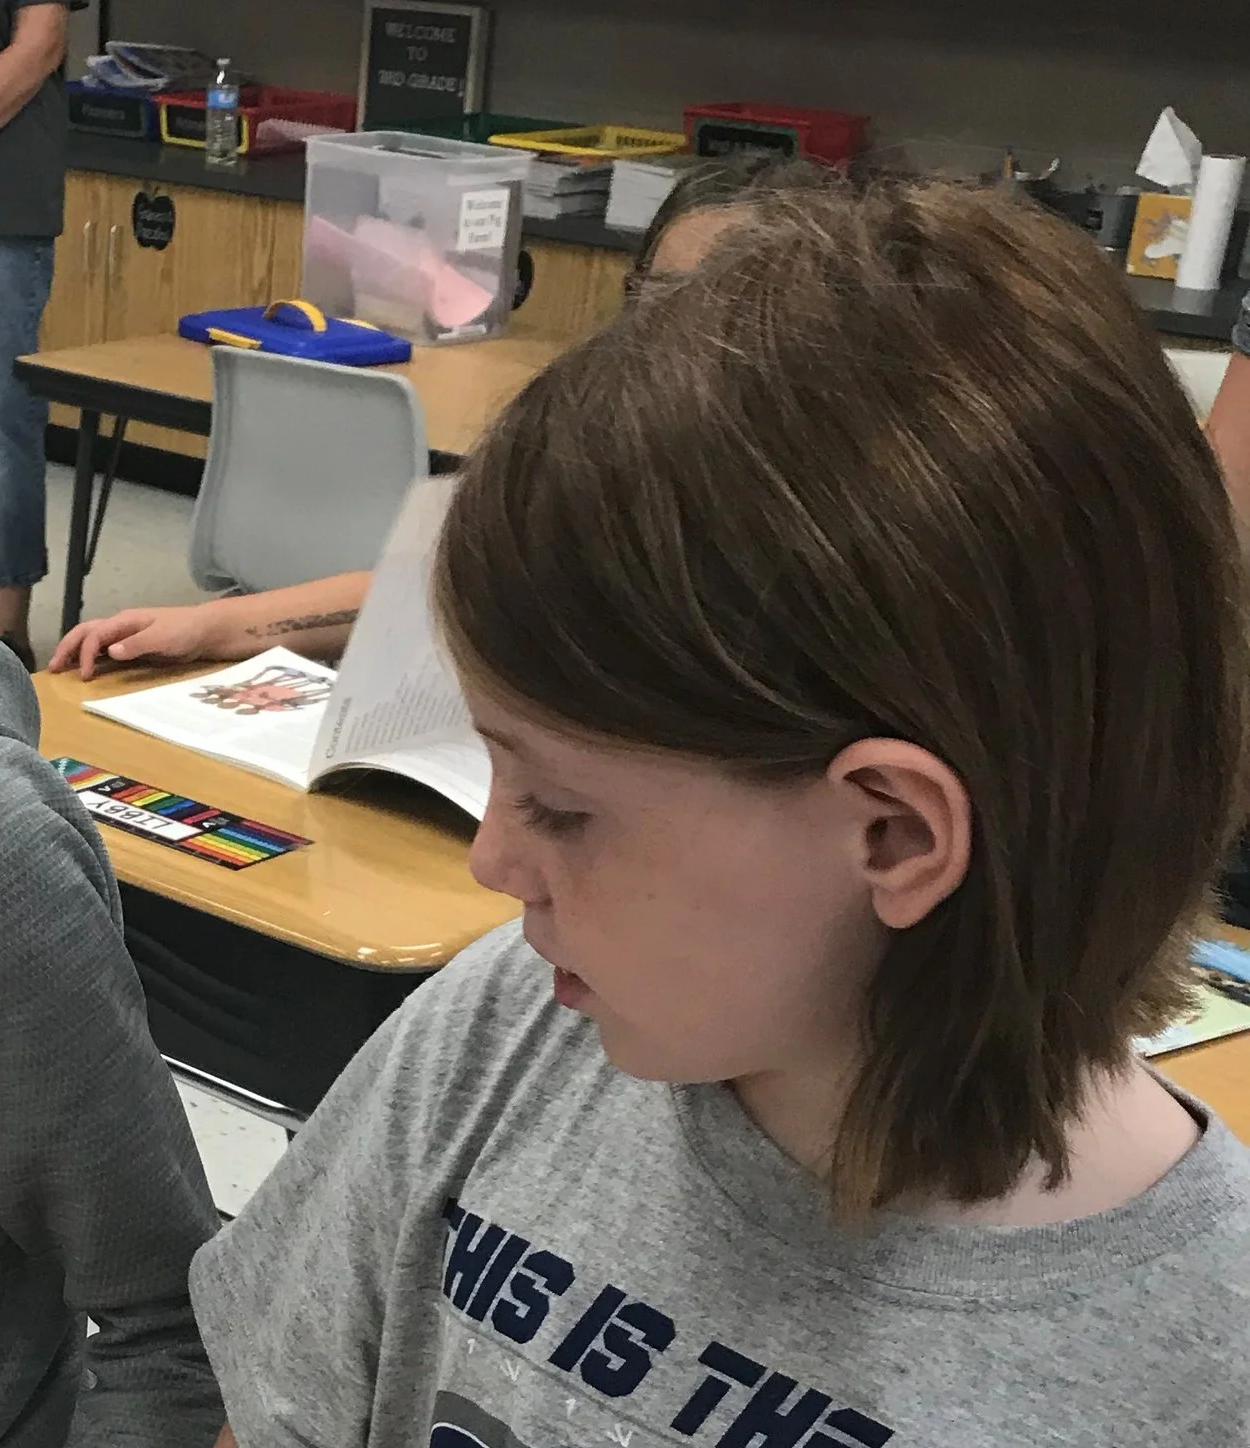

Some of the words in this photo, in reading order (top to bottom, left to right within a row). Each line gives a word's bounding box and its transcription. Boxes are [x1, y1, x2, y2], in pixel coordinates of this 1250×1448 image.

[384, 21, 458, 44] WELCOME
[406, 45, 429, 62] TO
[86, 799, 175, 830] LIBBY
[547, 1282, 676, 1398] IS
